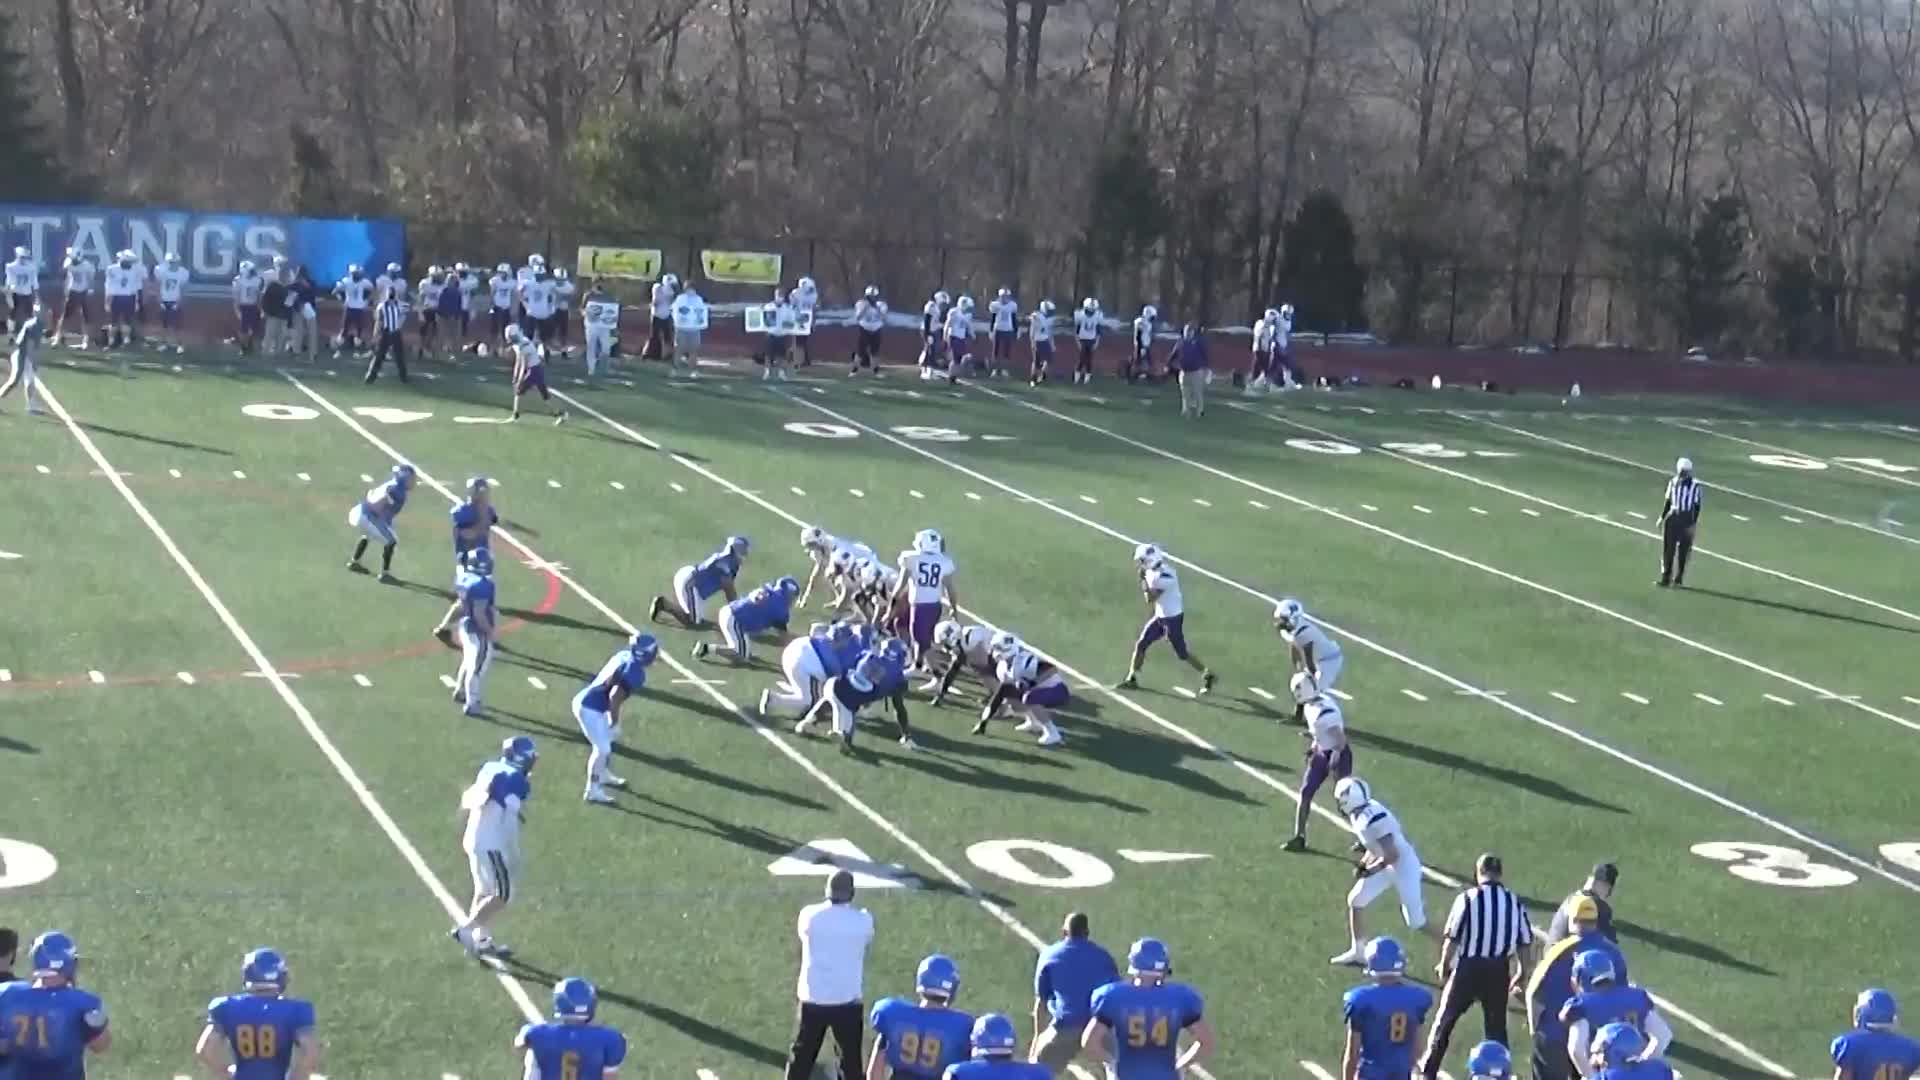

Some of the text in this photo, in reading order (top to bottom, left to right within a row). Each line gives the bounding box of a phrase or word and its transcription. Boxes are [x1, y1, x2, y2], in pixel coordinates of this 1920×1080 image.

[11, 215, 286, 276] TANGS
[918, 562, 941, 588] 58
[11, 1013, 48, 1049] 71
[236, 1024, 277, 1058] 88
[1127, 1015, 1168, 1048] 54
[900, 1031, 941, 1068] 99
